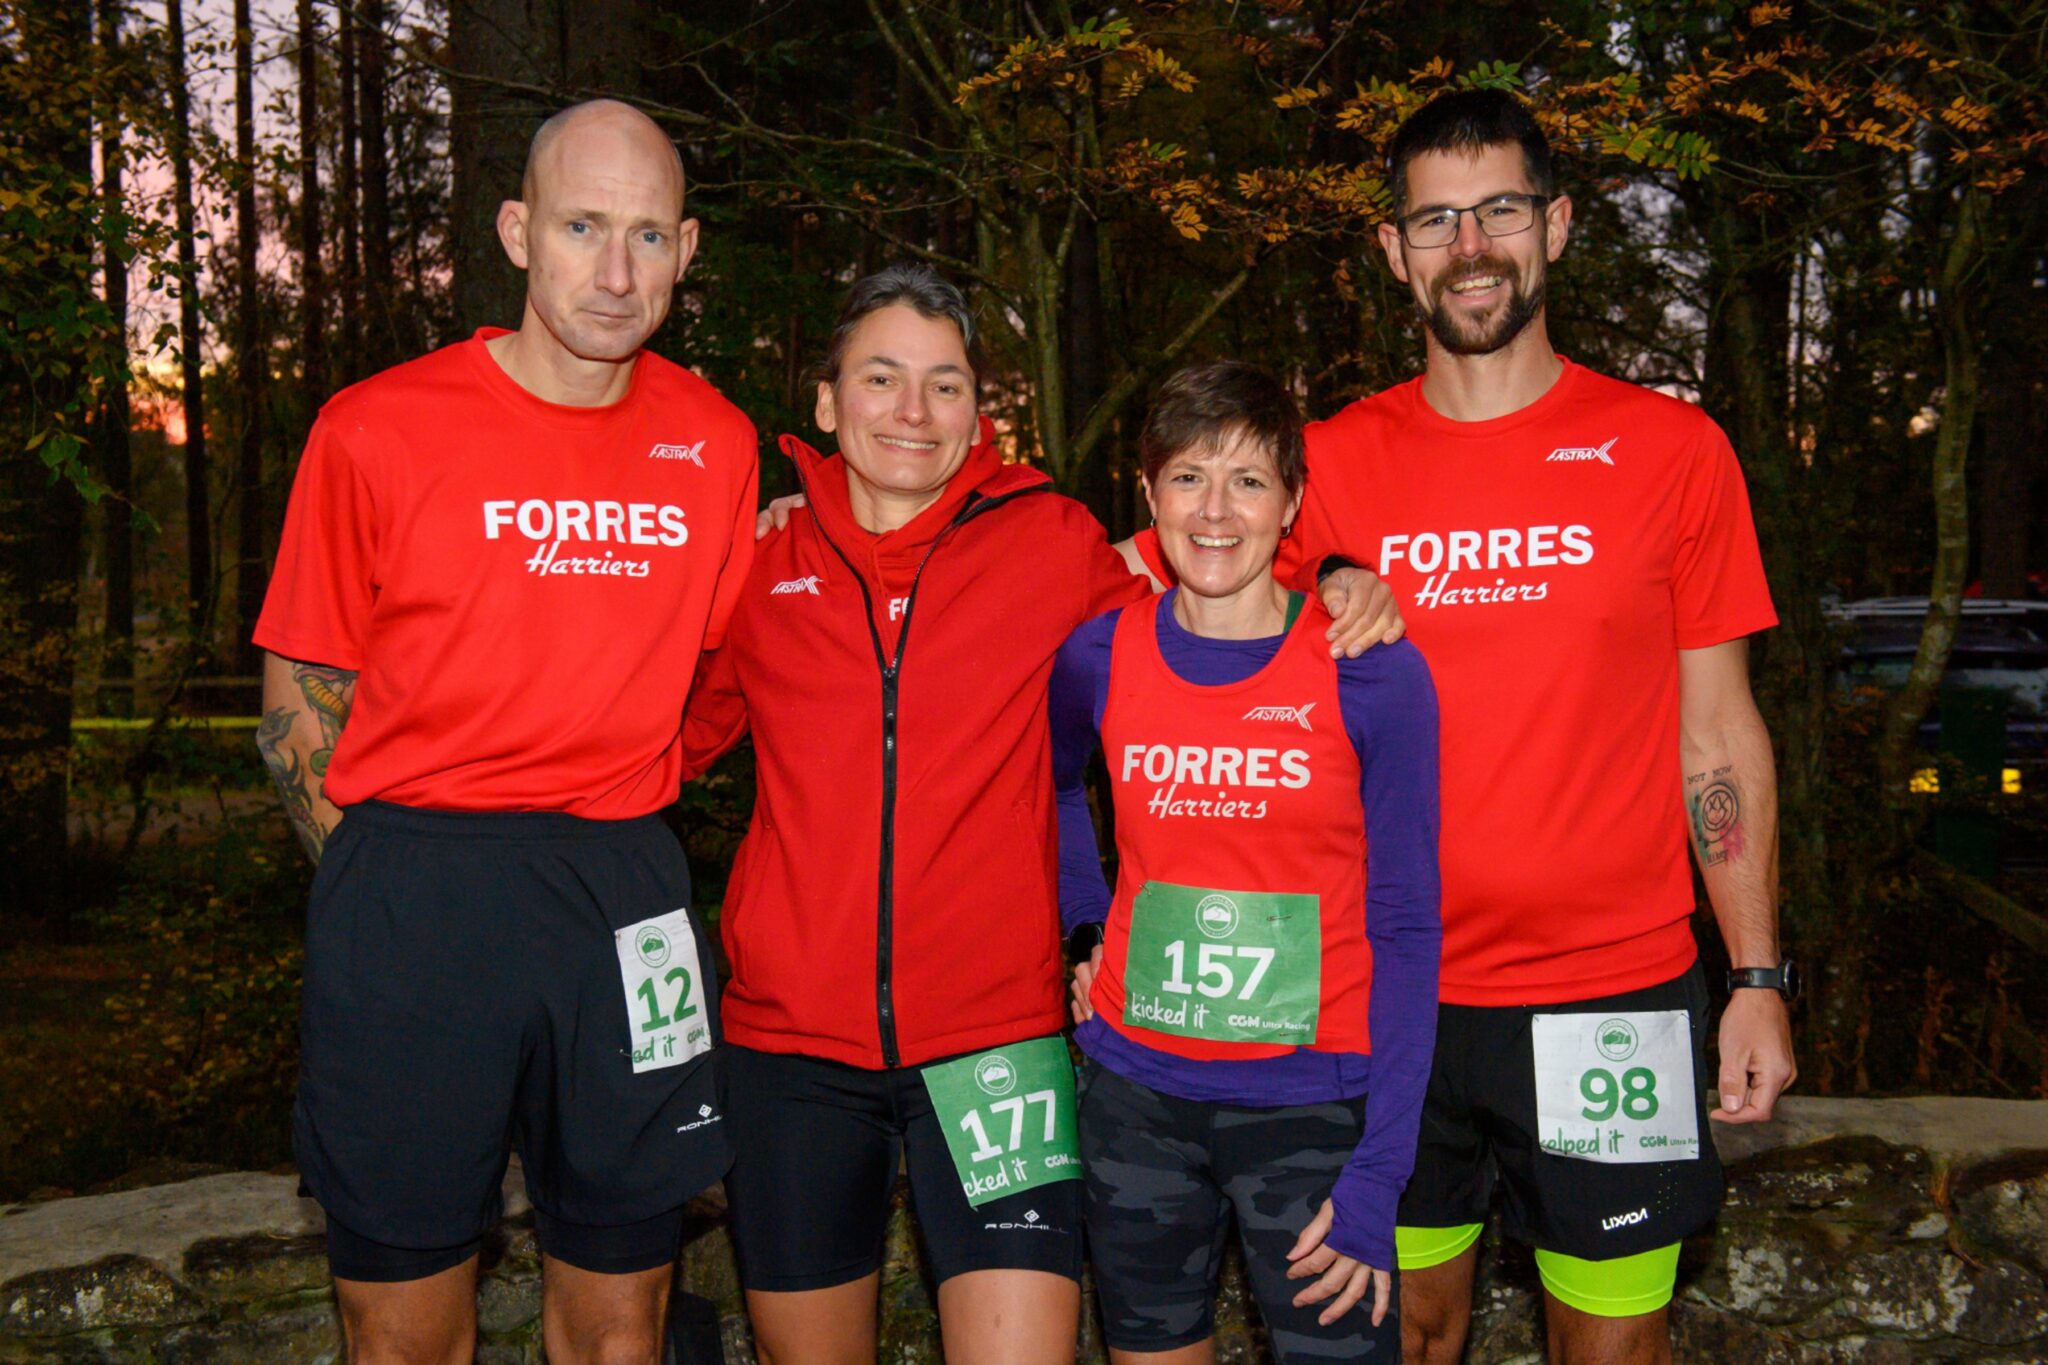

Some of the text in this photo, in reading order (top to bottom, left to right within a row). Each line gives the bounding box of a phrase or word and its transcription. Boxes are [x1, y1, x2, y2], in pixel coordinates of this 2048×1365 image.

[649, 440, 706, 469] FASTRAX
[1545, 437, 1619, 466] FASTRAX
[483, 499, 689, 547] FORRES
[525, 540, 650, 577] Harriers
[1379, 524, 1594, 576] FORRES
[1414, 572, 1549, 609] Harriers
[1242, 702, 1317, 732] FASTRAX
[1122, 744, 1311, 789] FORRES
[1147, 783, 1267, 819] Harriers
[1162, 939, 1275, 1000] 157
[637, 966, 697, 1033] 12
[1131, 992, 1210, 1030] kicked it
[1227, 1014, 1310, 1032] CGM Ultra Racing
[662, 1034, 677, 1057] it
[1579, 1066, 1659, 1122] 98
[960, 1089, 1056, 1163] 177
[1609, 1128, 1625, 1154] it
[1639, 1135, 1667, 1148] CGM
[1011, 1157, 1027, 1182] it
[1602, 1207, 1649, 1231] LIXADA
